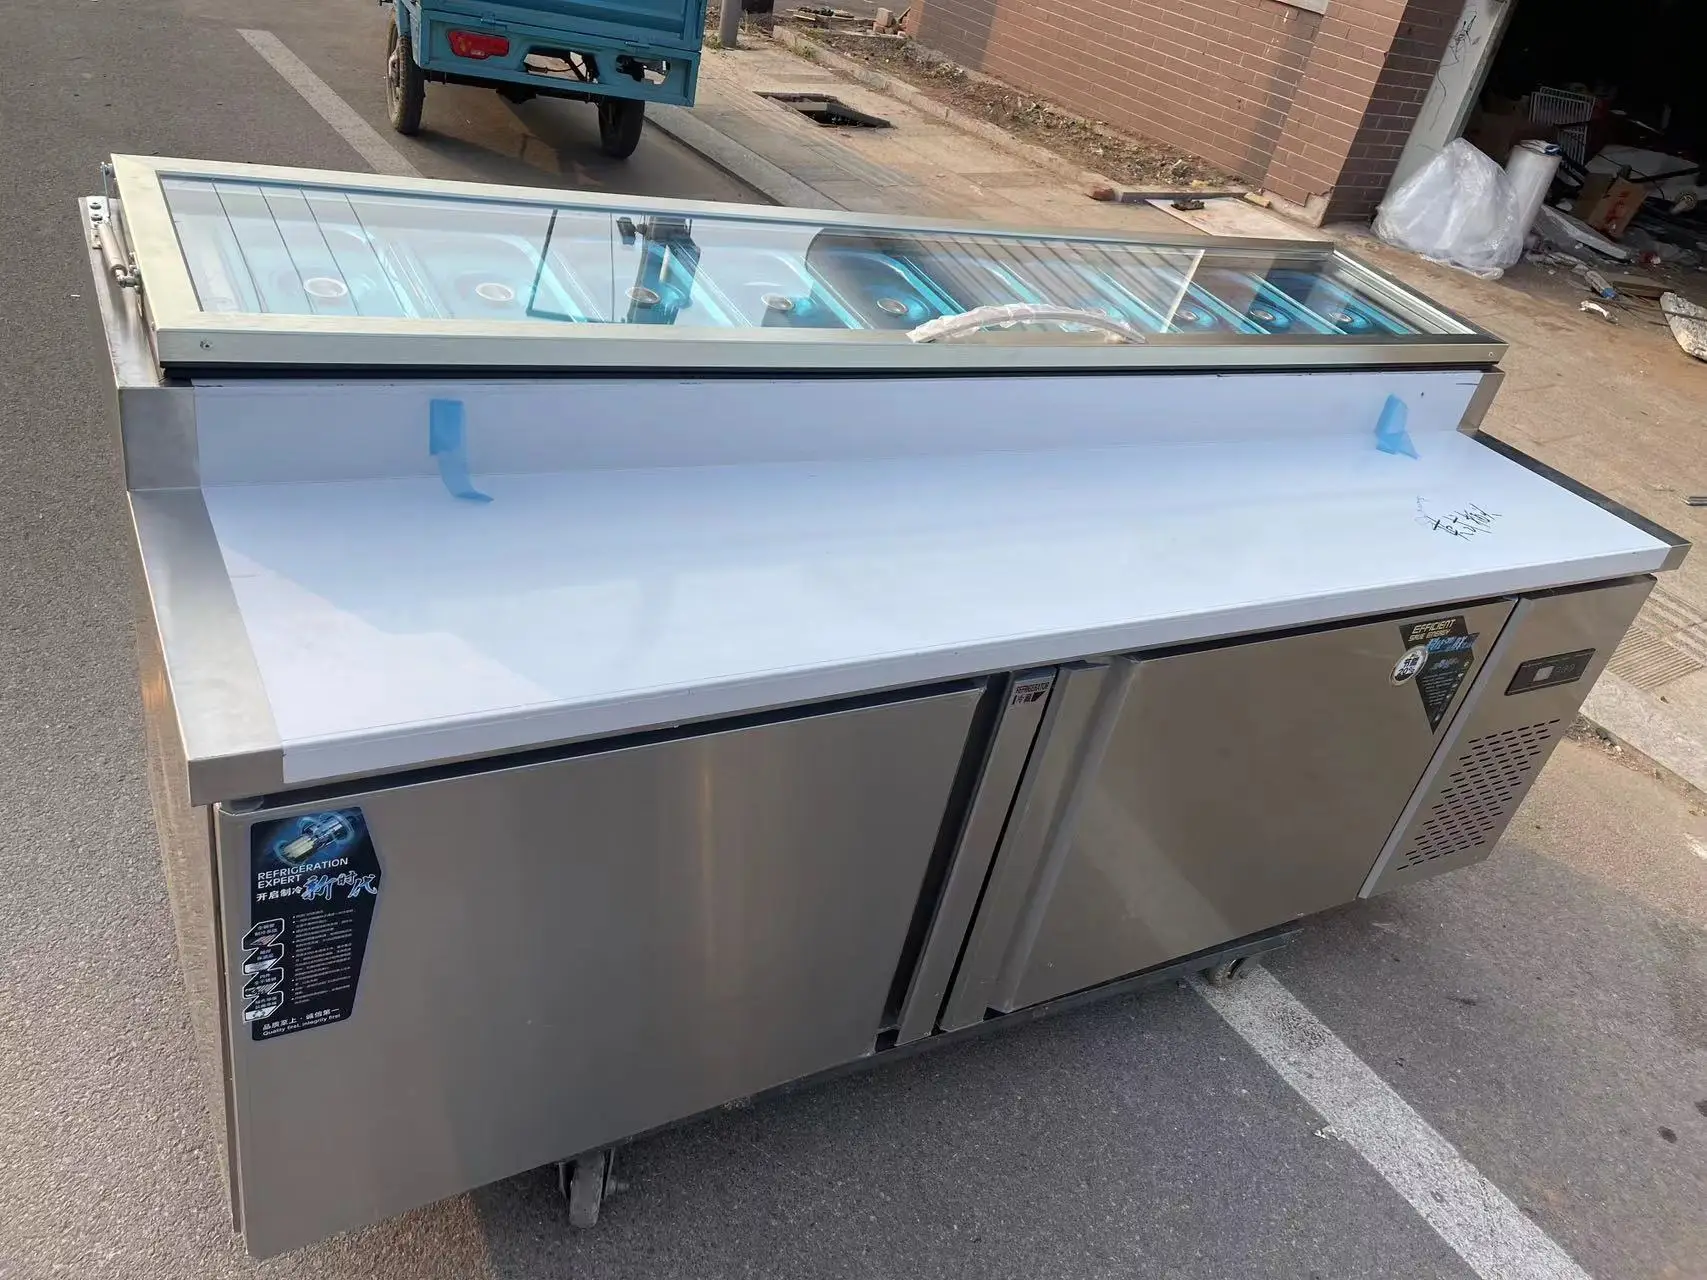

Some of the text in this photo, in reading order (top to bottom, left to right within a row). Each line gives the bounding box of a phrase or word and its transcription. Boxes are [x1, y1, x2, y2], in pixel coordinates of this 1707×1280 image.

[1412, 619, 1456, 634] EFFICIENT
[257, 857, 348, 881] REFRIGERATION
[257, 874, 302, 889] EXPERT
